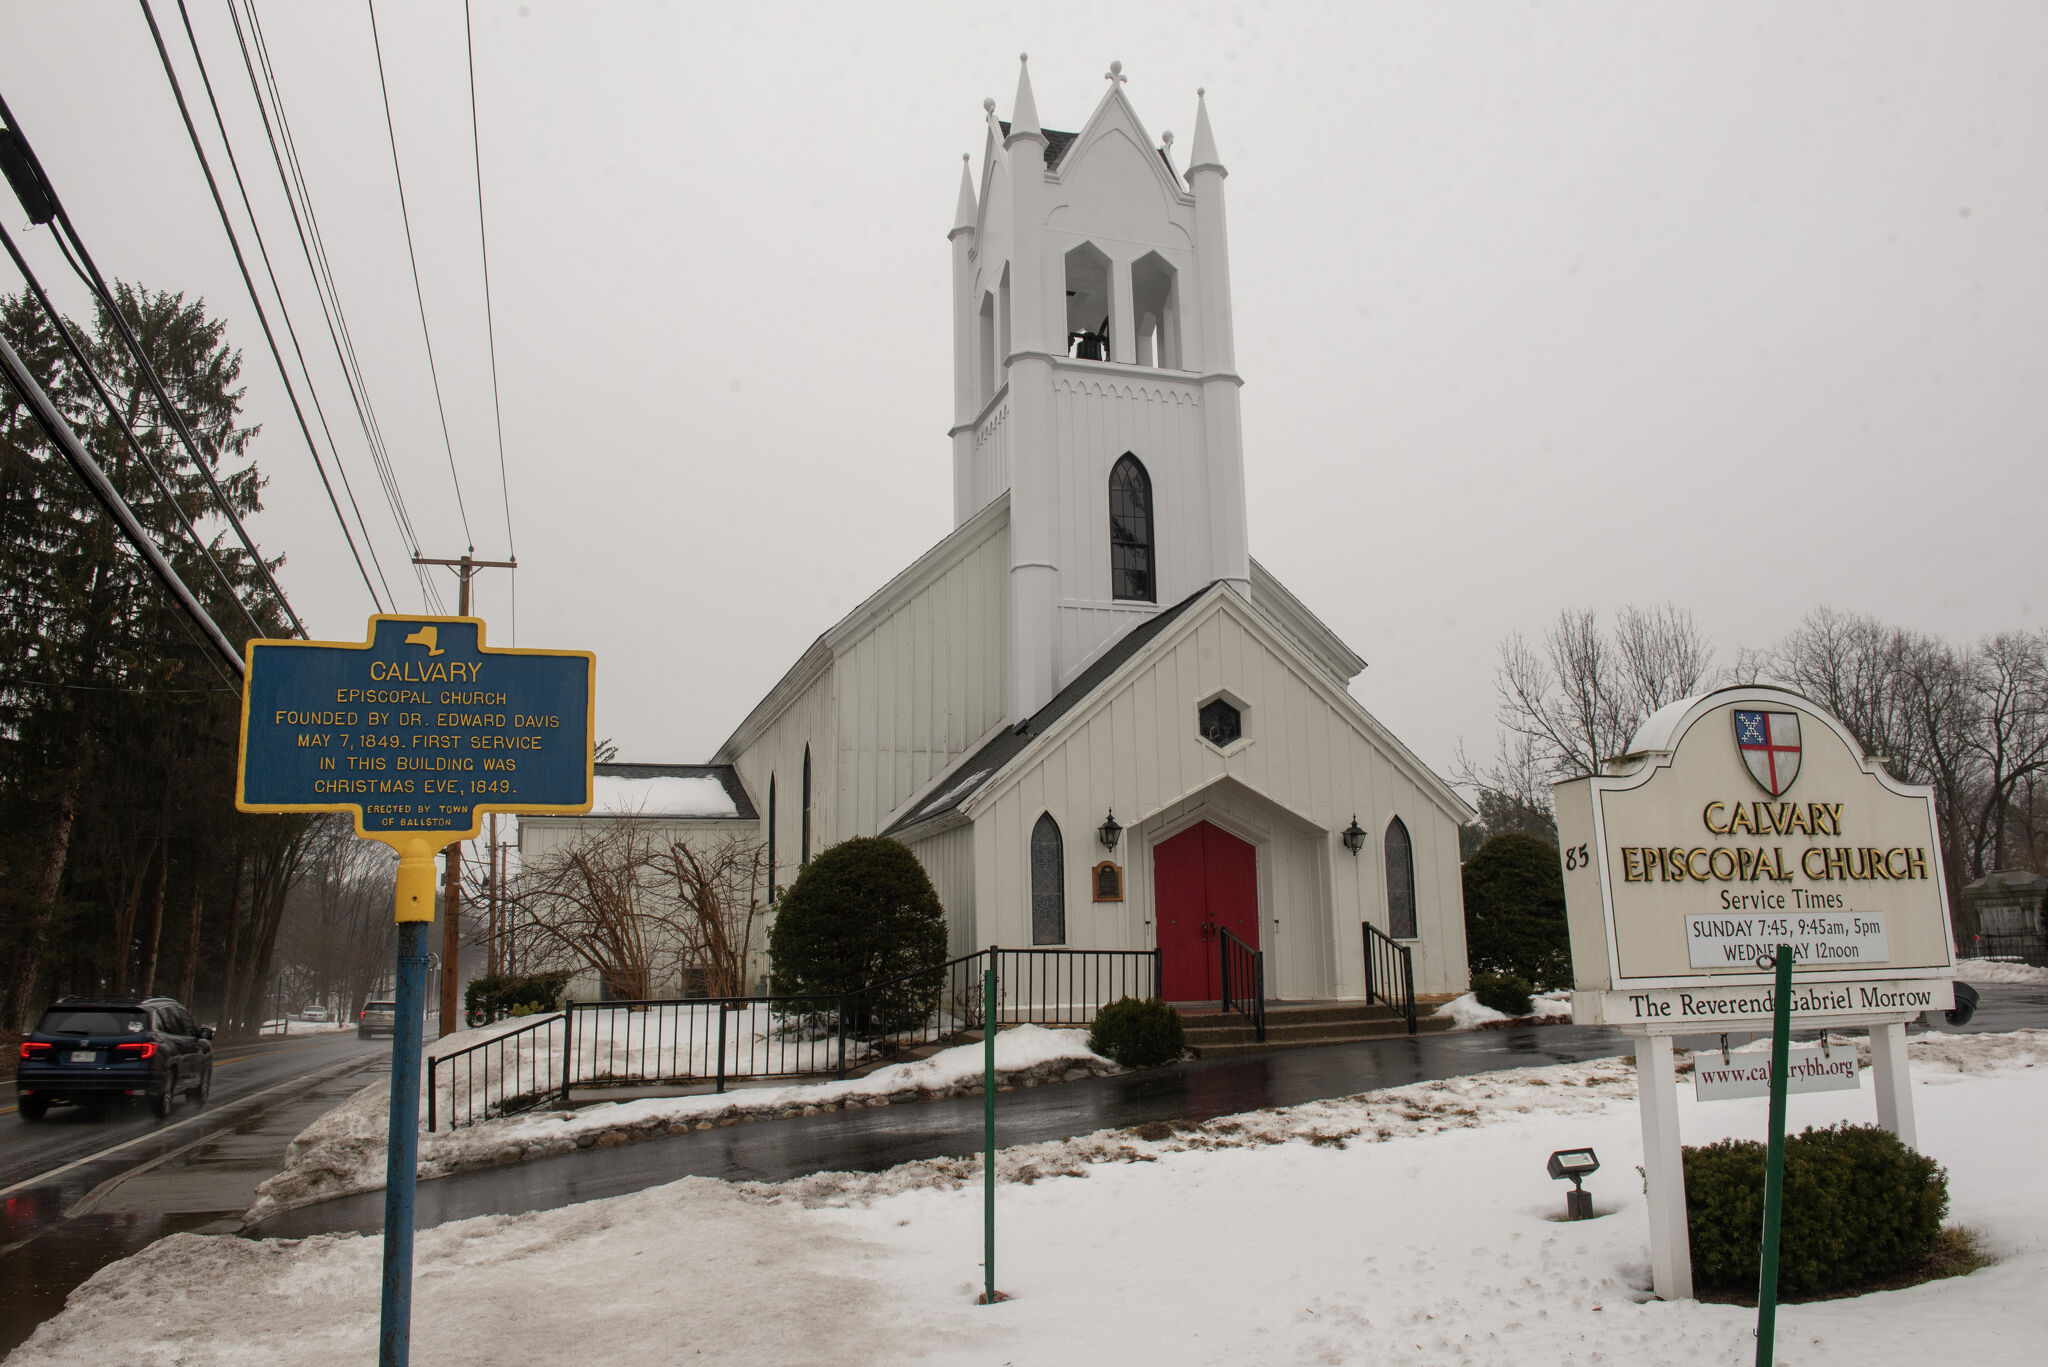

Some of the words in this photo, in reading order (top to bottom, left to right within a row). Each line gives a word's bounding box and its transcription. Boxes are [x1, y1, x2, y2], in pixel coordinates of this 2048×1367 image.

[370, 661, 482, 682] CALVARY
[337, 689, 432, 704] EPISCOPAL
[440, 691, 506, 705] CHURCH
[275, 710, 358, 726] FOUNDED
[368, 712, 389, 726] BY
[399, 712, 429, 727] DR.
[437, 713, 506, 728] EDWARD
[514, 715, 560, 728] DAVIS
[297, 734, 331, 748] MAY
[339, 734, 354, 751] 7,
[360, 734, 406, 749] 1849.
[412, 735, 462, 749] FIRST
[470, 736, 542, 750] SERVICE
[320, 757, 335, 771] IN
[346, 757, 387, 771] THIS
[396, 757, 474, 771] BUILDING
[482, 758, 517, 771] WAS
[314, 779, 415, 794] CHRISTMAS
[424, 780, 465, 796] EVE,
[470, 780, 517, 794] 1849.
[367, 805, 412, 814] ERECTED
[417, 805, 431, 814] BY
[438, 805, 468, 814] TOWN
[1703, 800, 1844, 836] CALVARY
[381, 818, 394, 826] OF
[400, 818, 451, 826] BALLSTON
[1565, 842, 1589, 871] 85
[1621, 847, 1794, 882] EPISCOPAL
[1801, 847, 1928, 881] CHURCH
[1720, 889, 1785, 910] Service
[1791, 888, 1844, 909] Times
[1693, 919, 1752, 938] SUNDAY
[1758, 919, 1793, 938] 7:45,
[1798, 918, 1849, 937] 9:45am,
[1854, 917, 1881, 937] 5pm
[1723, 942, 1809, 961] WEDNEAY
[1815, 943, 1859, 960] 12noon
[1629, 994, 1672, 1018] The
[1680, 990, 1775, 1016] Reverend
[1859, 985, 1932, 1008] Morrow
[1701, 1057, 1855, 1085] www.calrybh.org
